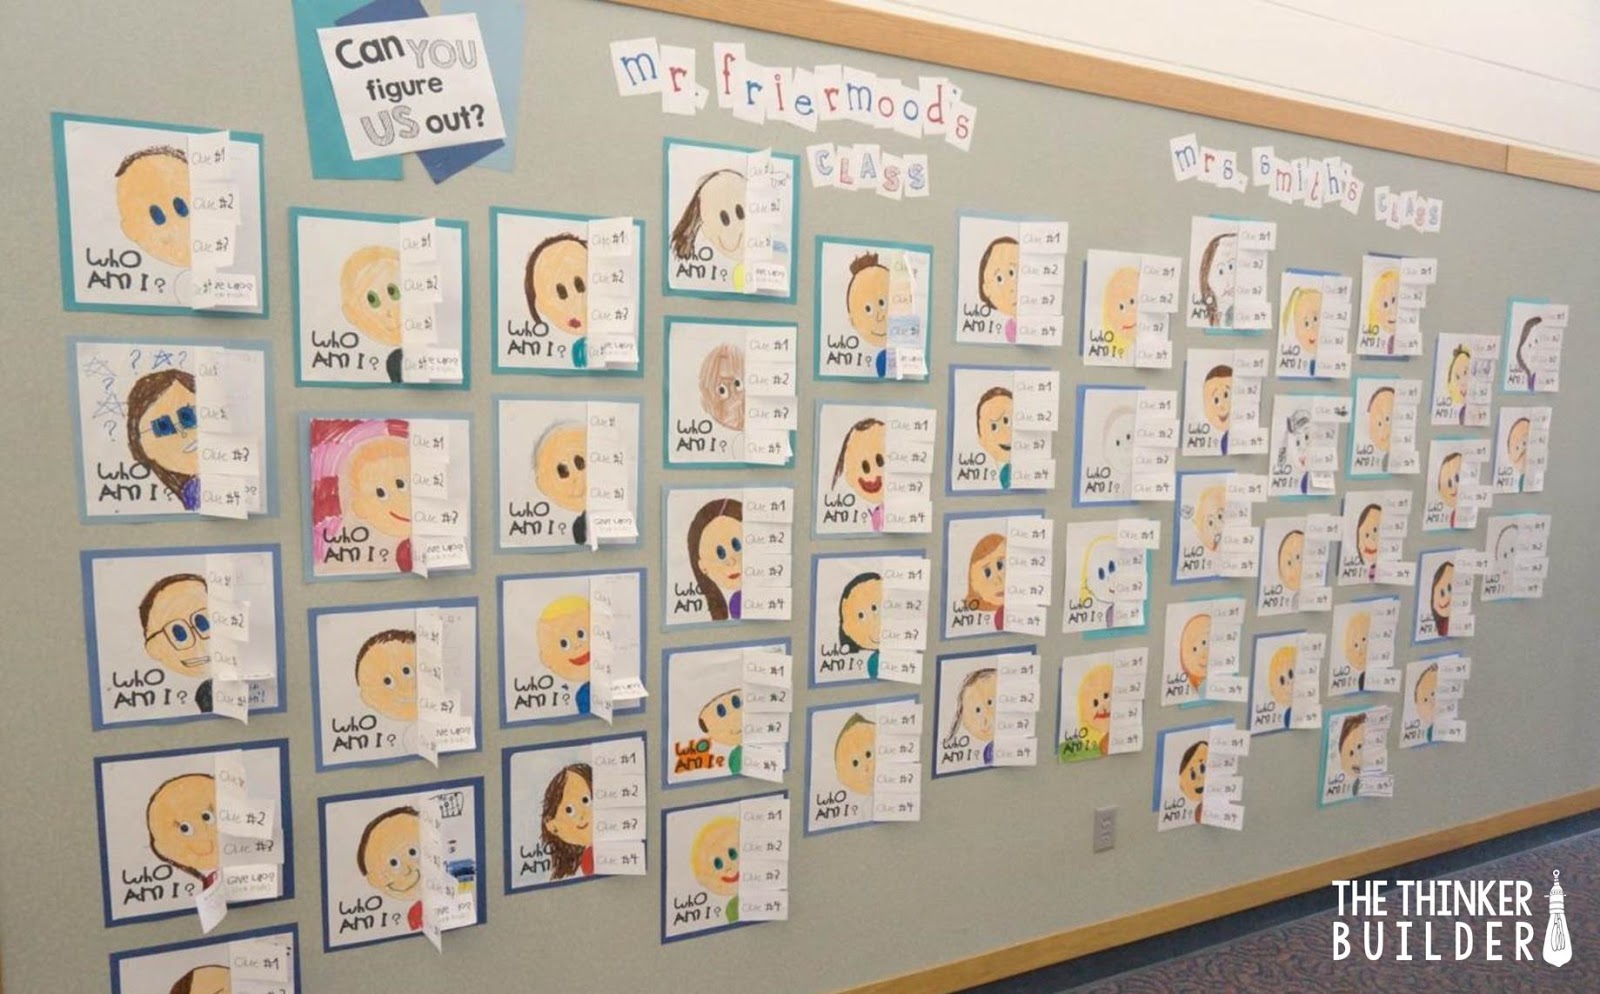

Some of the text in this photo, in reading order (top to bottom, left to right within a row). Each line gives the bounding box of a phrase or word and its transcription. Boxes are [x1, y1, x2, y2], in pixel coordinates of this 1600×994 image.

[335, 35, 478, 69] Can YOU
[367, 77, 443, 102] figure
[723, 53, 969, 139] friermood's
[361, 104, 485, 146] US out?
[815, 150, 925, 191] CLASS
[774, 339, 789, 350] #1
[773, 372, 789, 384] #2
[621, 754, 637, 764] #1
[622, 786, 638, 798] #2
[246, 812, 266, 825] #2
[264, 957, 279, 968] #1
